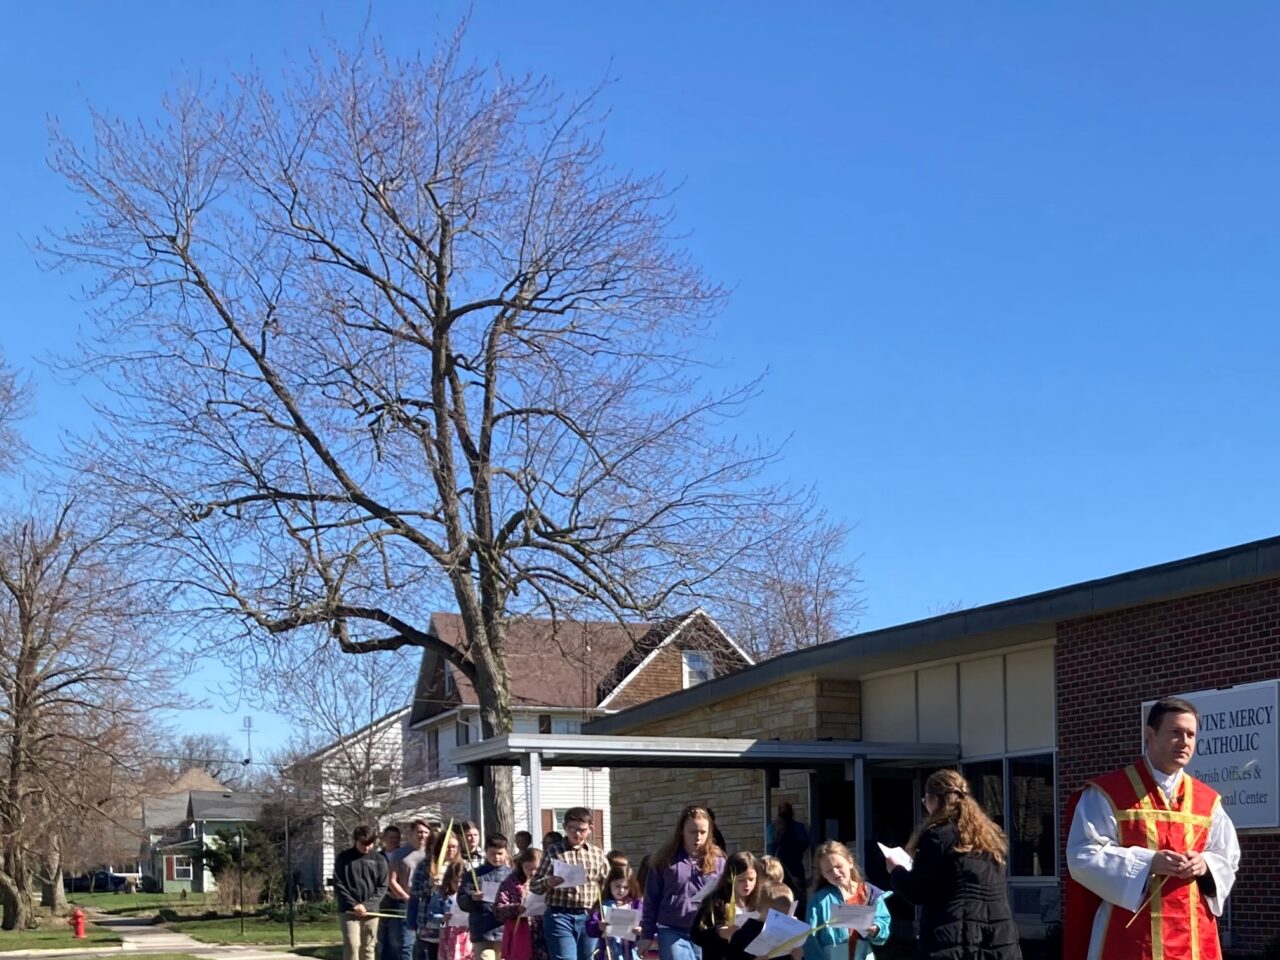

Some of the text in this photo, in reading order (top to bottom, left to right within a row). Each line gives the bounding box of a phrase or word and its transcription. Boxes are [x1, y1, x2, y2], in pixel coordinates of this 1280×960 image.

[1198, 705, 1274, 732] VINE MERCY
[1196, 732, 1260, 756] CATHOLIC
[1194, 764, 1262, 783] Parish Offices &
[1239, 789, 1269, 806] Center
